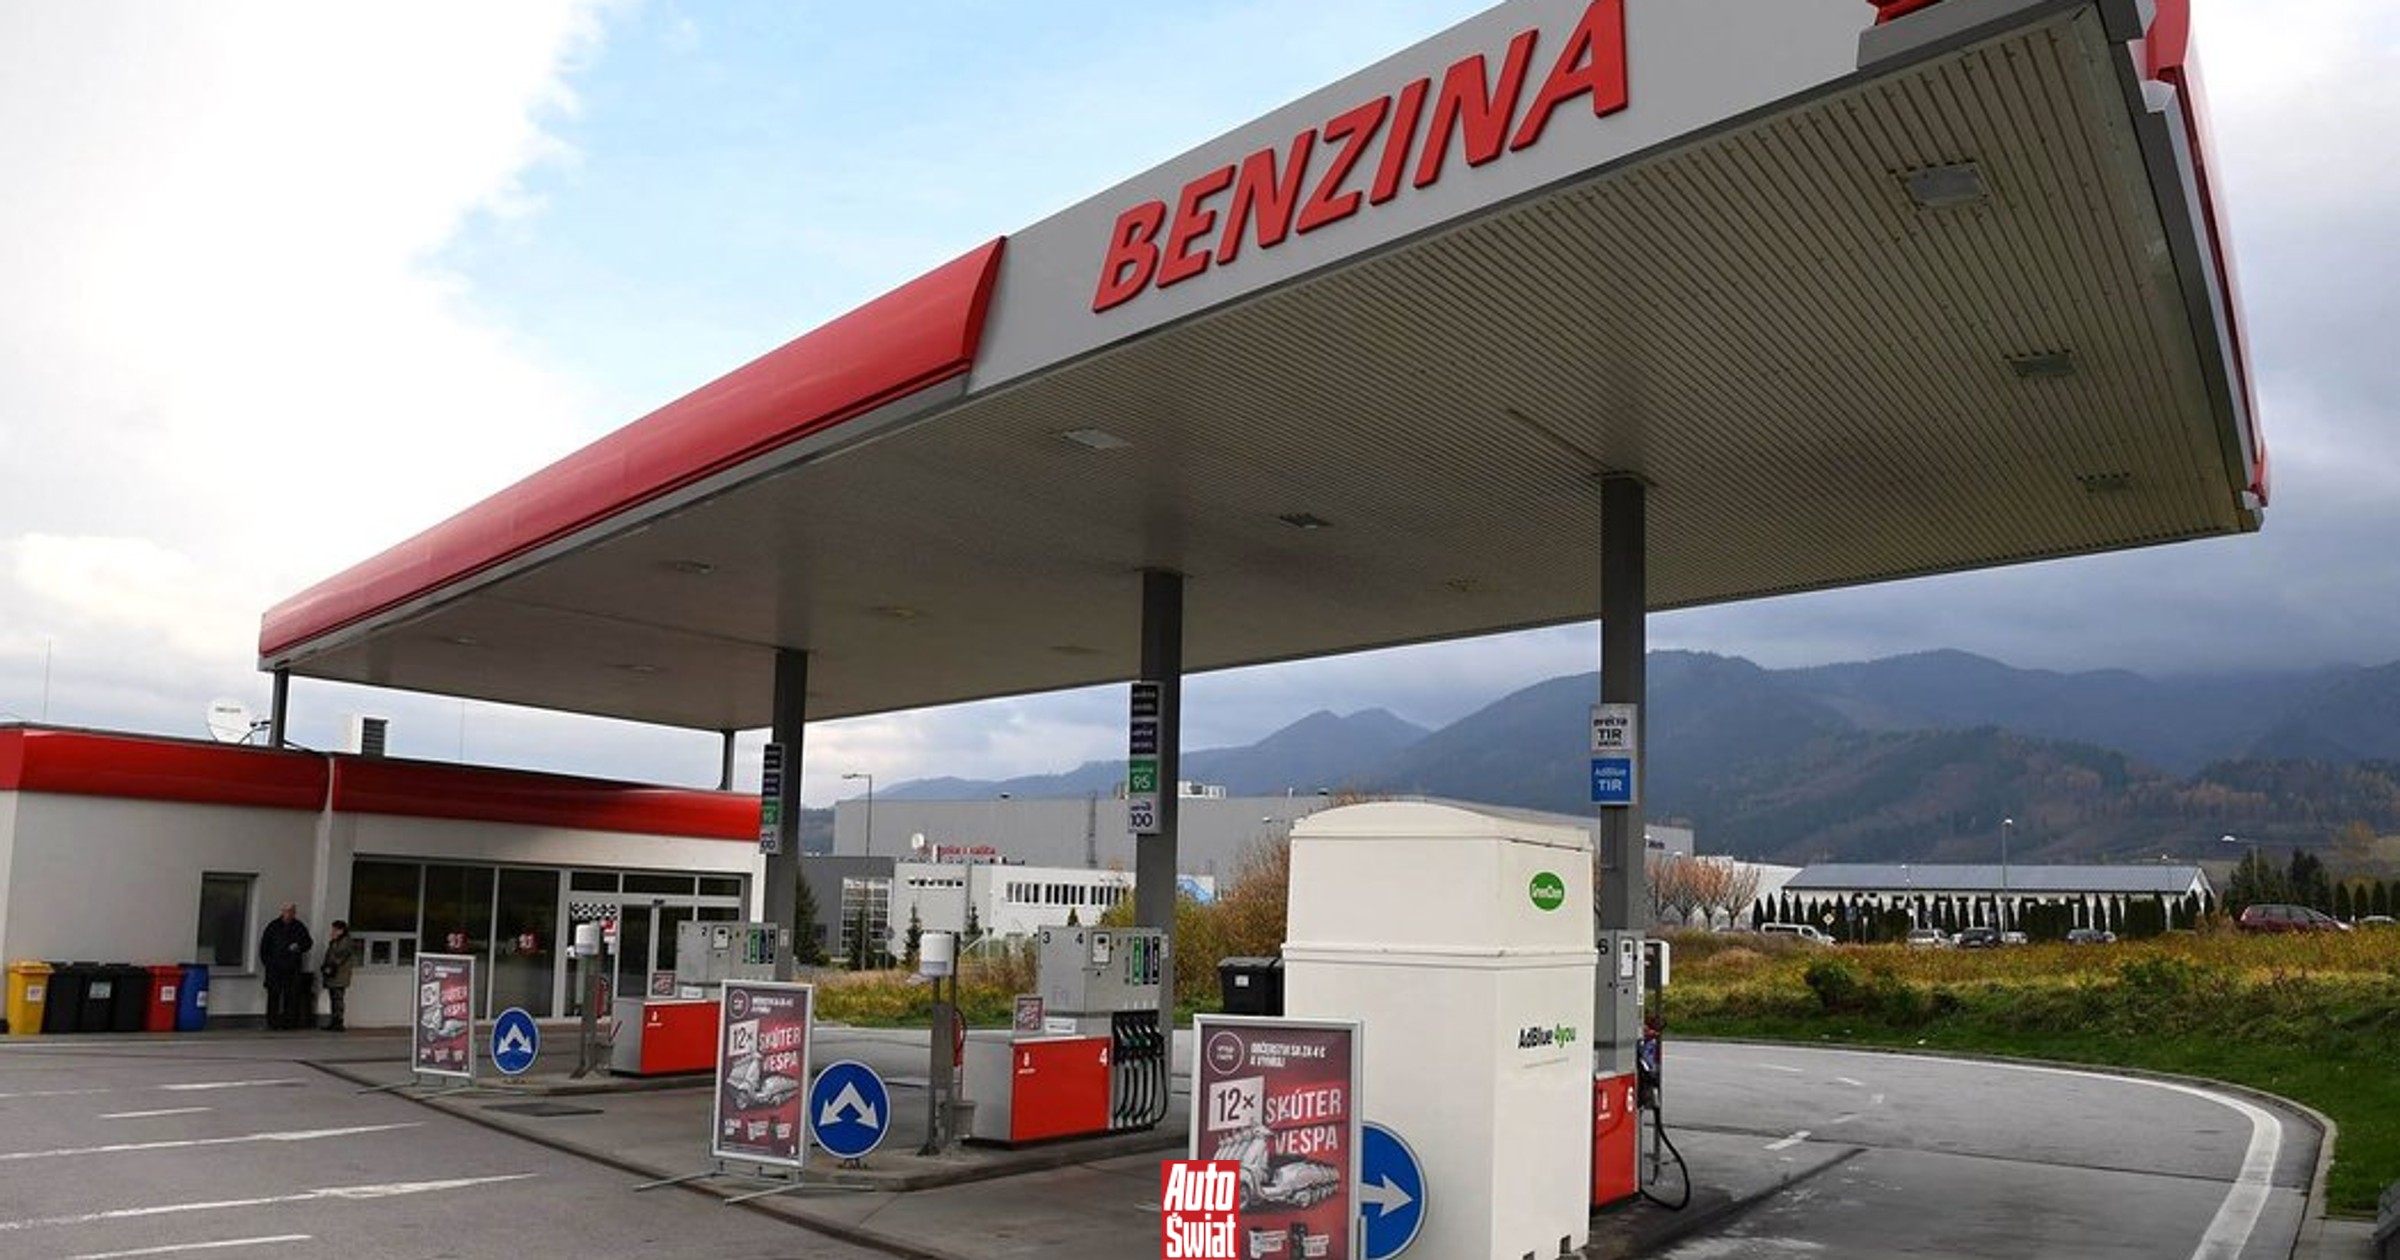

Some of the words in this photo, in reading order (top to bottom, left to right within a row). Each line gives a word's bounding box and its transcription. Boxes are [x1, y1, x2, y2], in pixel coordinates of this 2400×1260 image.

[1093, 0, 1629, 314] BENZINA
[1598, 728, 1622, 741] TIR
[1133, 775, 1151, 790] 95
[1598, 778, 1622, 791] TIR
[1131, 812, 1153, 828] 100
[1042, 931, 1050, 944] 3
[1076, 932, 1083, 944] 4
[1518, 1026, 1553, 1049] AdBlue
[1554, 1023, 1577, 1049] 4you
[763, 1051, 798, 1072] VESPA
[1099, 1047, 1108, 1066] 4
[1265, 1088, 1342, 1124] SKÚTER
[1626, 1086, 1634, 1112] 6
[1275, 1125, 1339, 1155] VESPA
